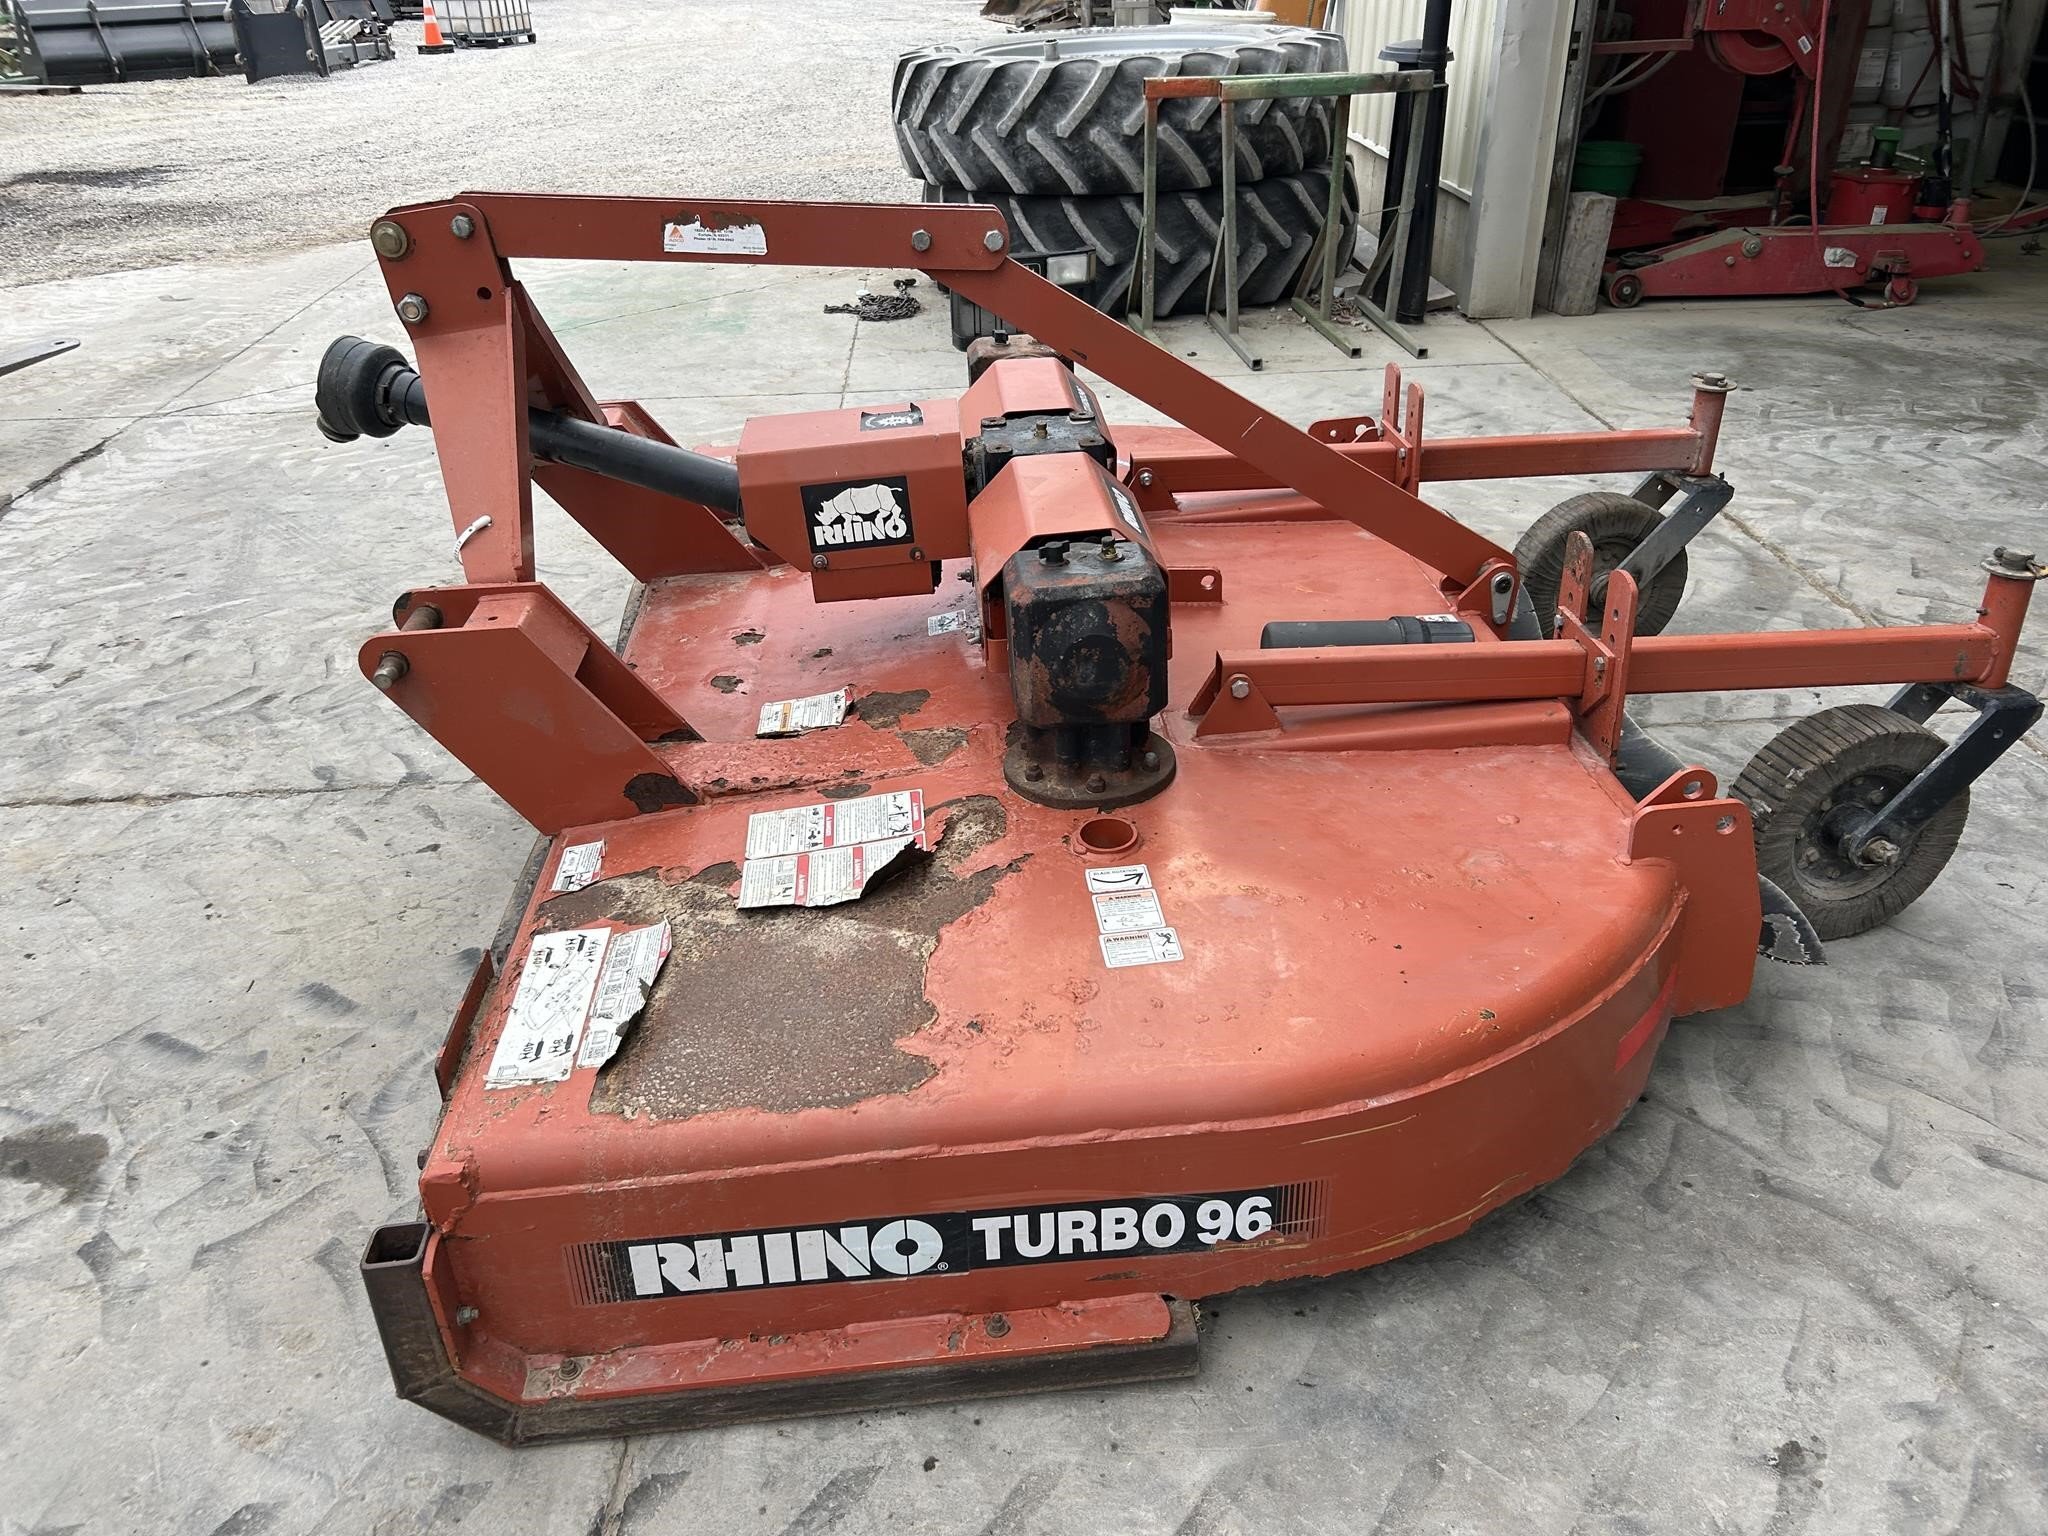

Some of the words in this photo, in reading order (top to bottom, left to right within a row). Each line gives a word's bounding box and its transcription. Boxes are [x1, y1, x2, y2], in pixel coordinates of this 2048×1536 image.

[814, 518, 907, 546] RHINO
[1113, 934, 1148, 942] WARNING
[628, 1219, 944, 1296] RHINO
[972, 1202, 1185, 1260] TURBO
[1196, 1196, 1272, 1244] 96
